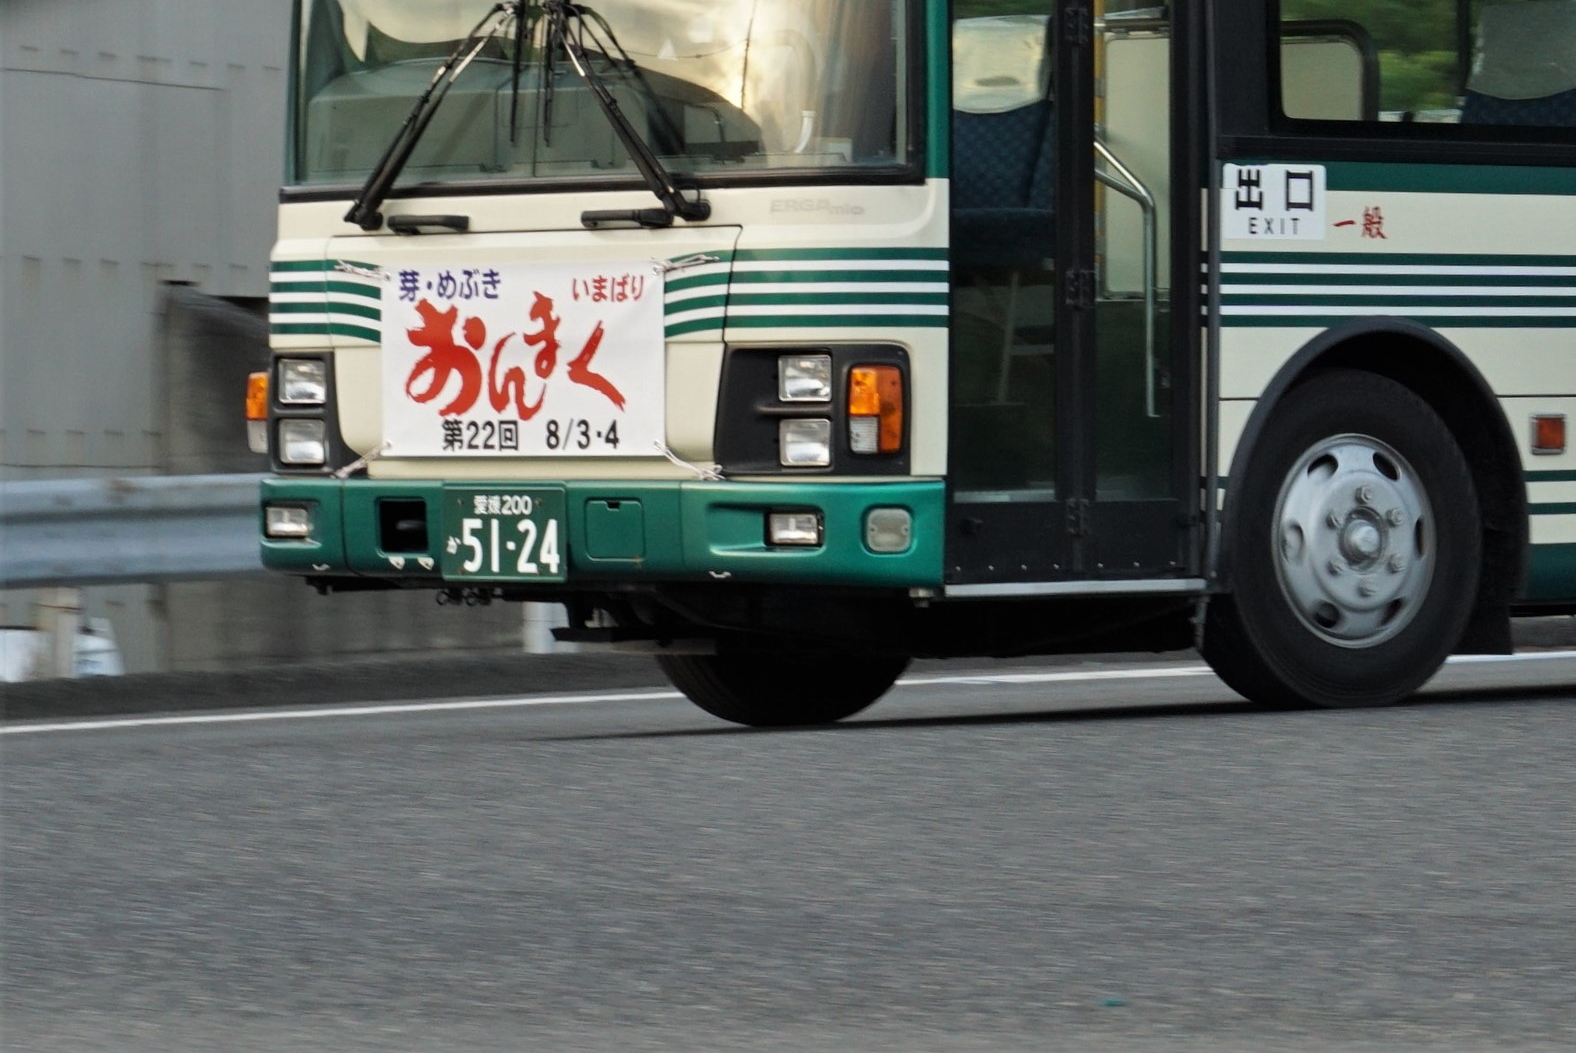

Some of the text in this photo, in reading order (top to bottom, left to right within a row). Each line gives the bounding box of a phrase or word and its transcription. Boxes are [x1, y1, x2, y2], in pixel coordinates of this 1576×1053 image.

[1235, 168, 1314, 211] 出口
[1248, 217, 1301, 235] EXIT
[1333, 206, 1388, 239] 一般
[399, 269, 645, 302] 芽・めぶき いまばり
[405, 291, 627, 421] おんまく
[441, 418, 519, 451] 第22回
